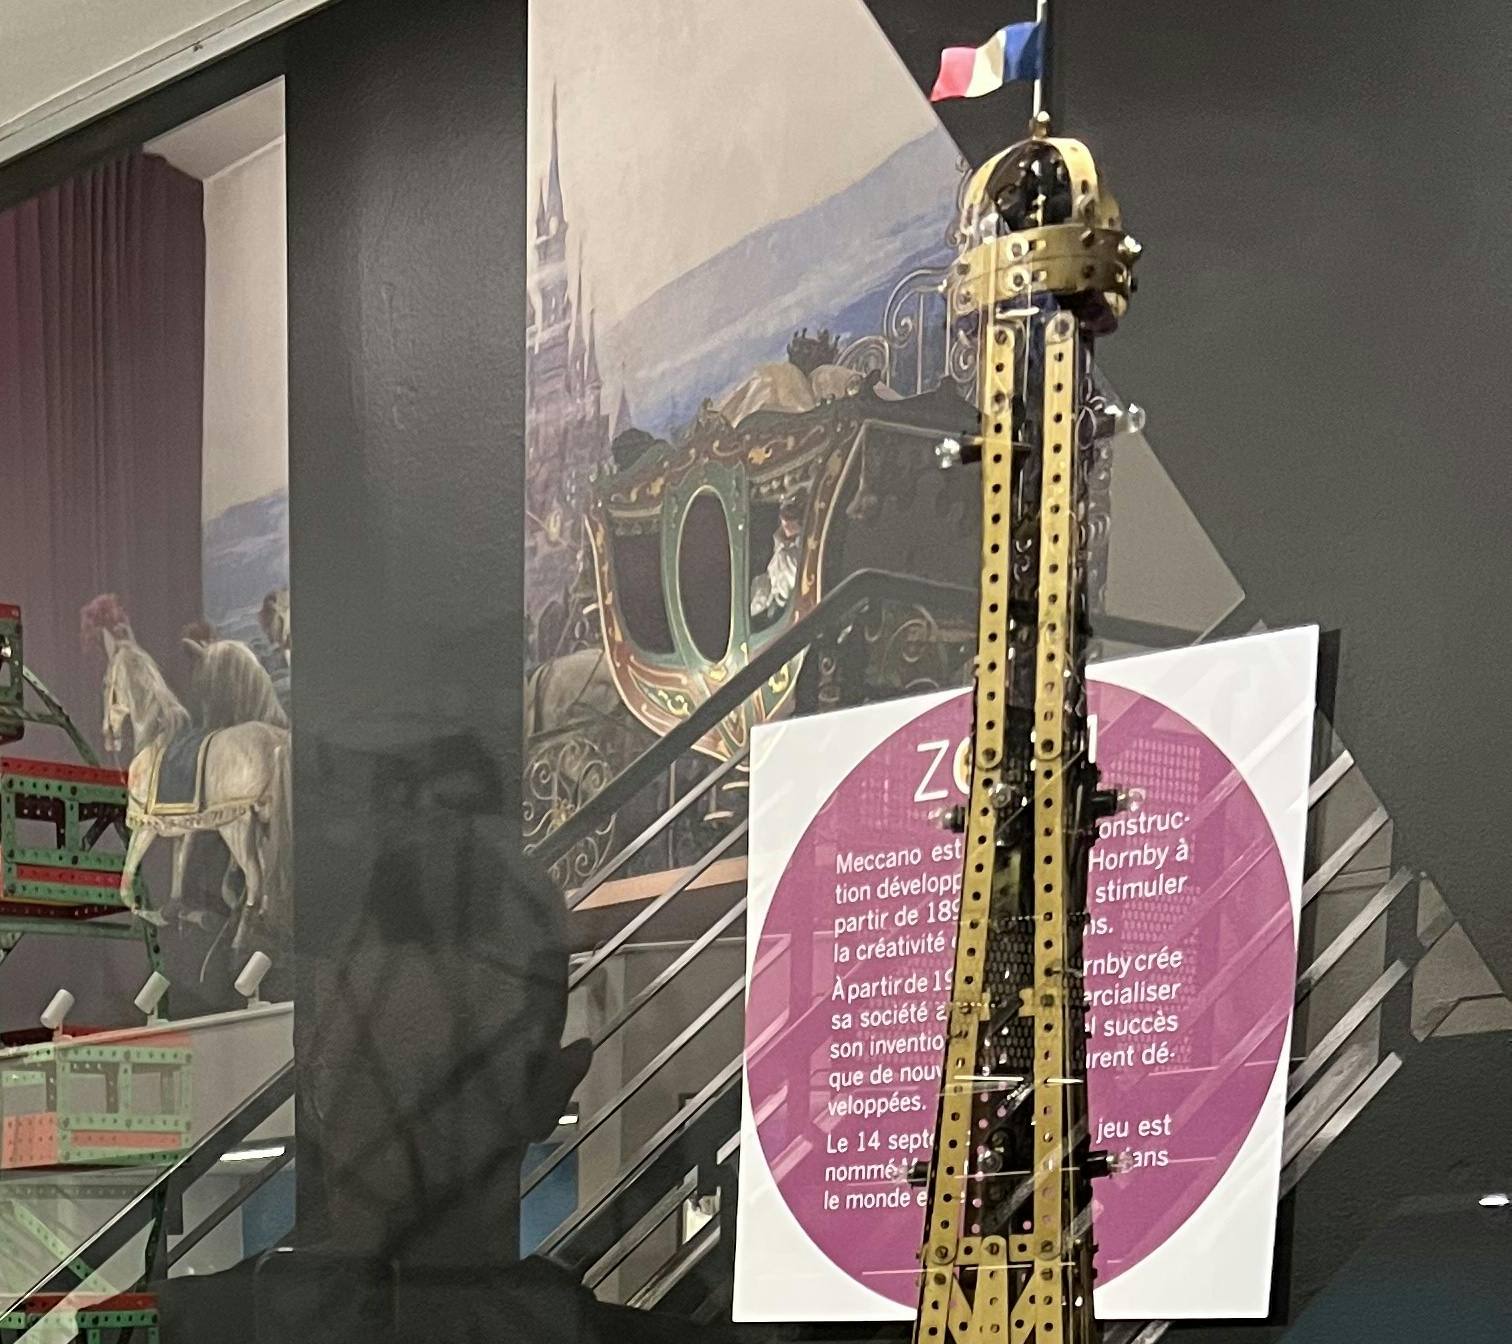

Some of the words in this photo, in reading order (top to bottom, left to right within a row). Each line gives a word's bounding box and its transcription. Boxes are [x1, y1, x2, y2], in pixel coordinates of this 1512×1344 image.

[1099, 810, 1190, 839] onstruc-
[836, 848, 921, 873] Meccano
[931, 838, 962, 862] est
[1089, 843, 1168, 872] Hornby
[1175, 838, 1189, 861] à
[835, 884, 871, 904] tion
[1095, 873, 1188, 903] stimuler
[834, 909, 888, 939] partir
[894, 905, 919, 928] de
[927, 898, 960, 924] 189
[833, 935, 848, 962] la
[853, 930, 944, 960] créativité
[1135, 946, 1183, 970] crée
[832, 976, 846, 1000] À
[848, 976, 901, 1003] partir
[903, 972, 928, 995] de
[831, 1014, 852, 1029] sa
[860, 1001, 927, 1027] société
[1104, 1010, 1179, 1036] succès
[830, 1042, 864, 1058] son
[869, 1033, 944, 1057] inventio
[1142, 1041, 1175, 1064] dé-
[829, 1069, 864, 1090] que
[869, 1065, 894, 1084] de
[828, 1092, 927, 1119] veloppées.
[827, 1132, 850, 1154] Le
[858, 1130, 880, 1151] 14
[1096, 1118, 1129, 1144] jeu
[1138, 1114, 1171, 1136] est
[824, 1191, 839, 1209] le
[845, 1182, 911, 1208] monde
